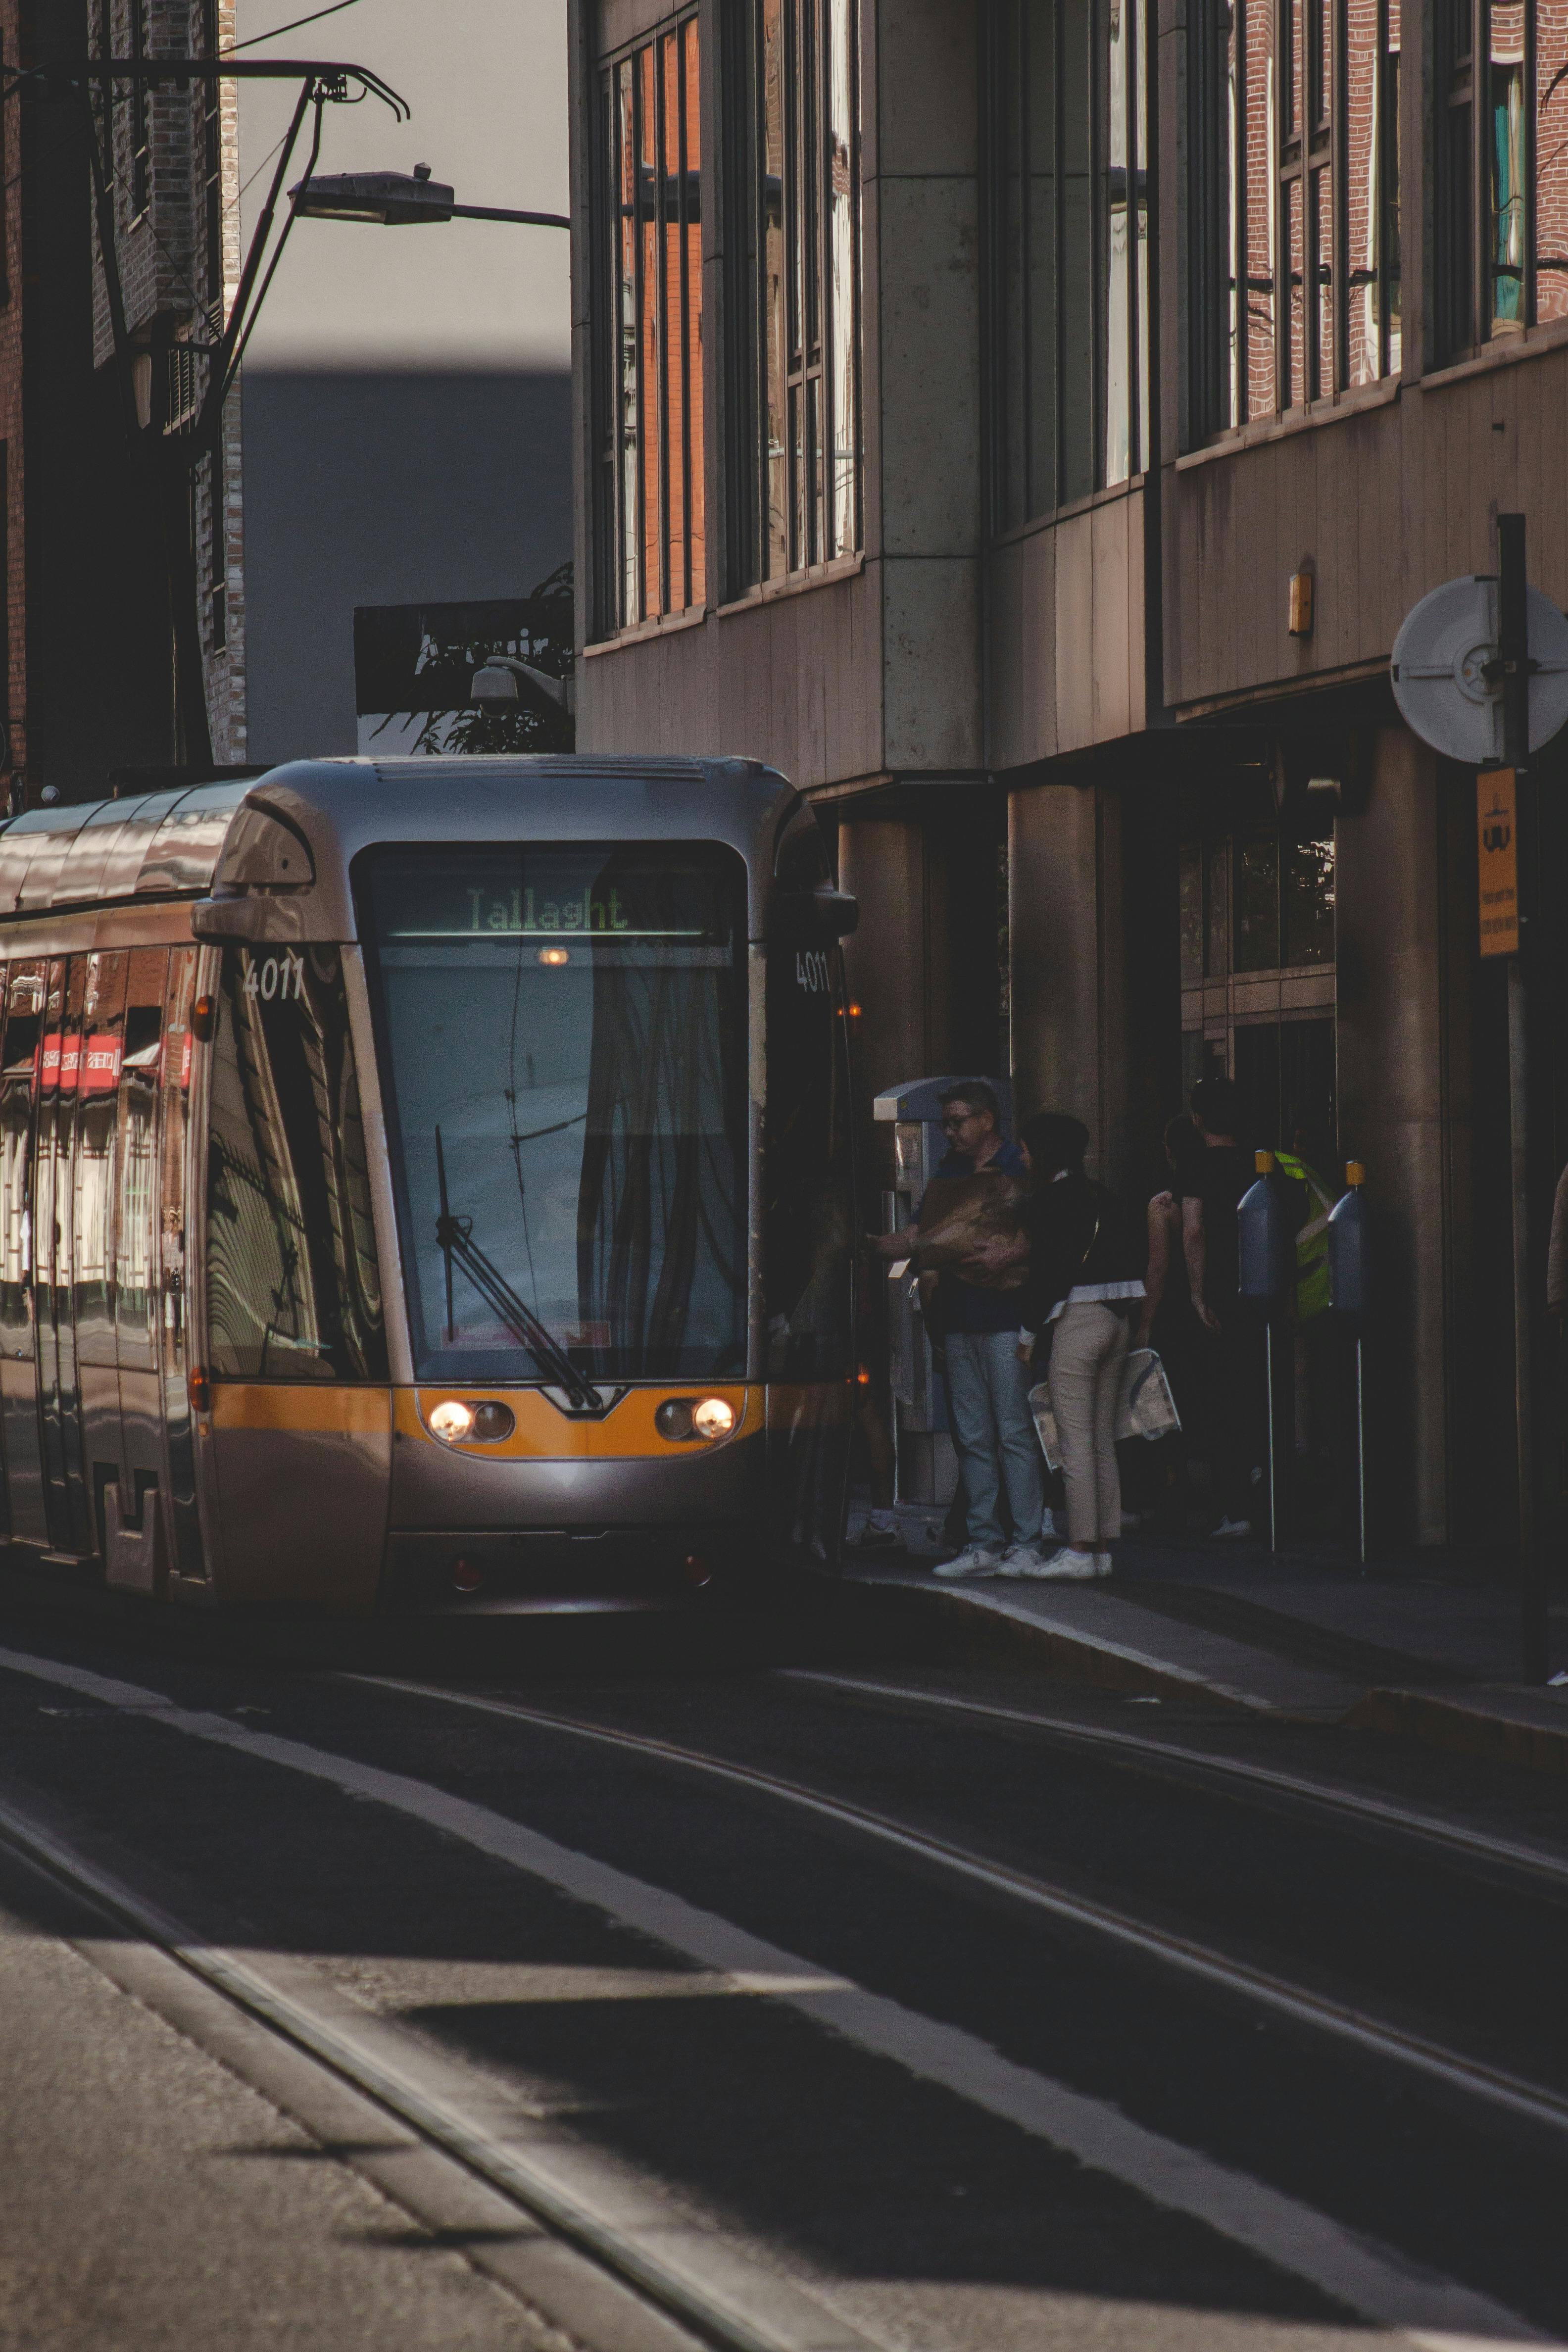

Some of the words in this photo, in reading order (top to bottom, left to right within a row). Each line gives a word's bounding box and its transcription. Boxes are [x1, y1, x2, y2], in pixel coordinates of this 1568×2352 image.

[467, 887, 628, 930] Tallaght
[242, 957, 304, 1000] 4011
[796, 951, 831, 992] 4011
